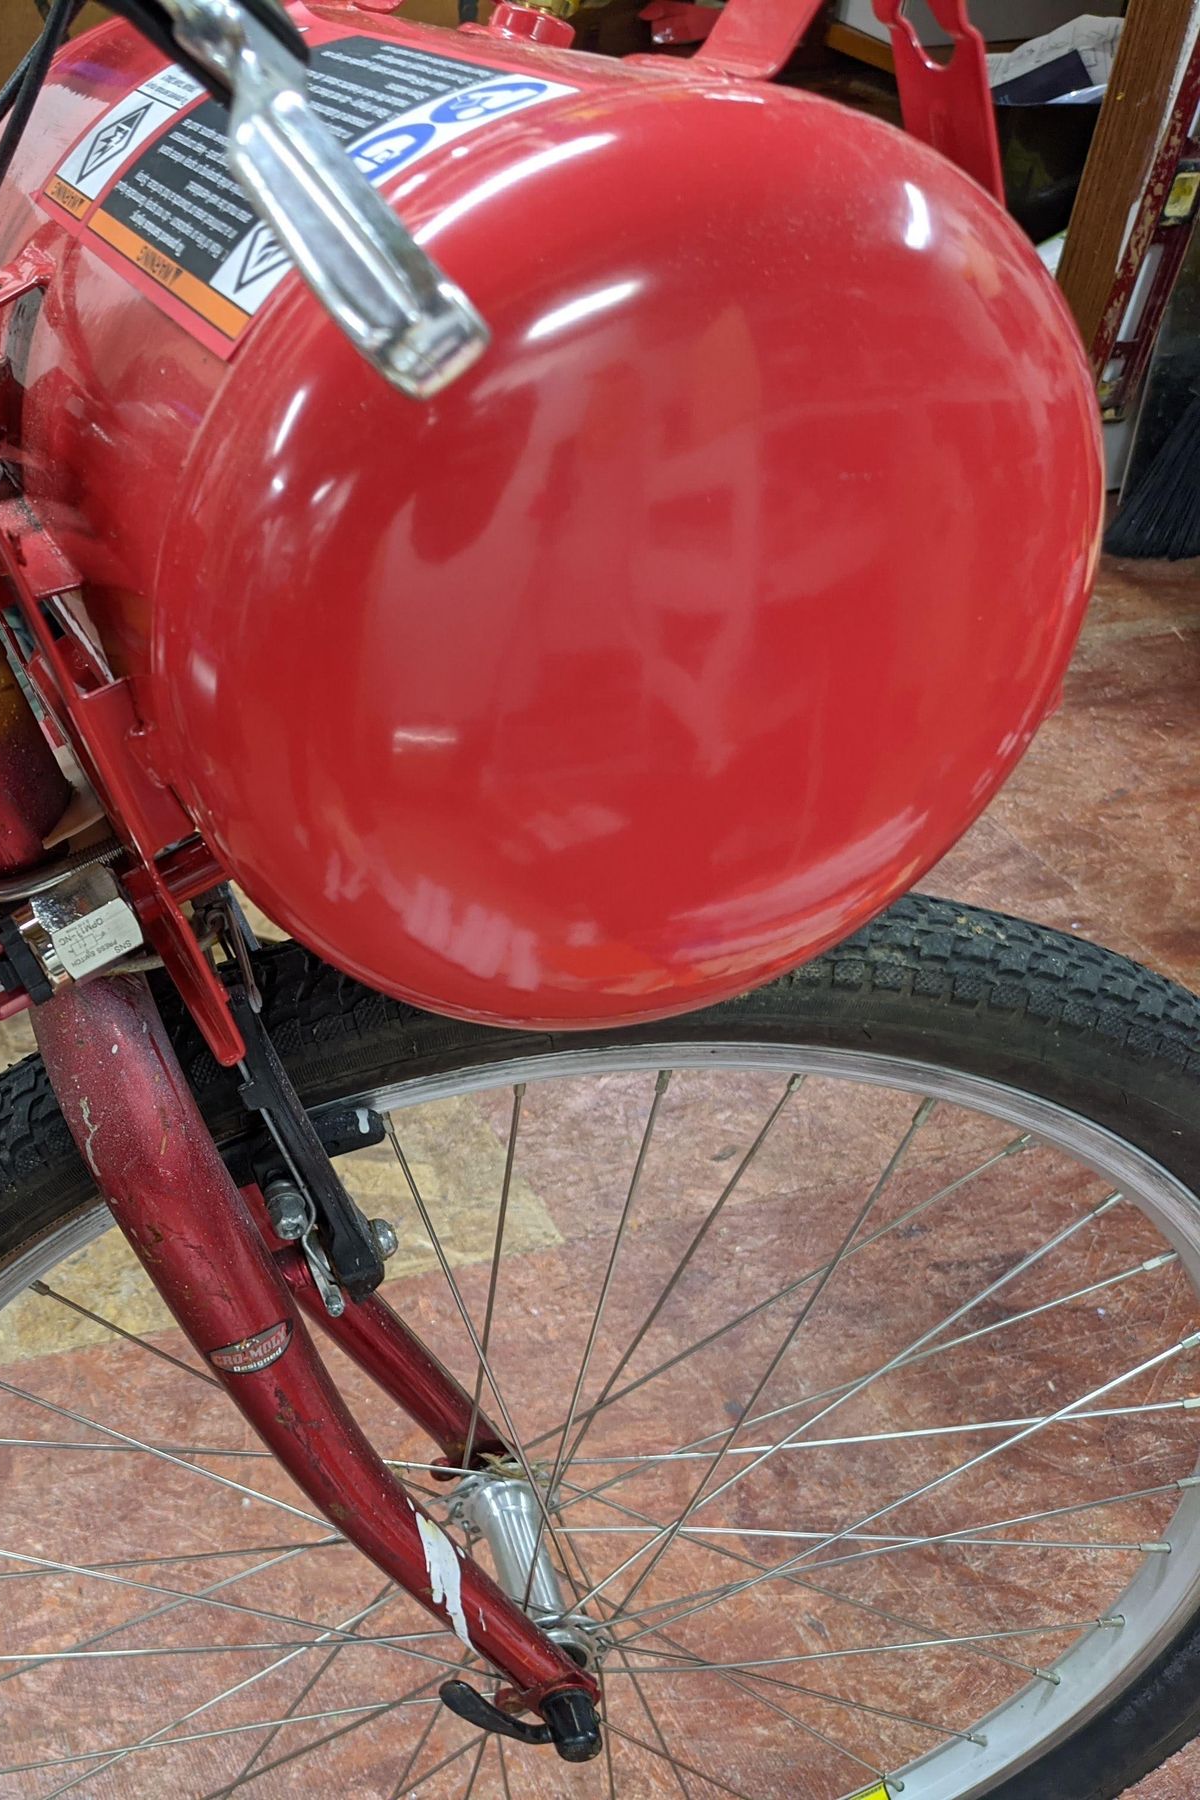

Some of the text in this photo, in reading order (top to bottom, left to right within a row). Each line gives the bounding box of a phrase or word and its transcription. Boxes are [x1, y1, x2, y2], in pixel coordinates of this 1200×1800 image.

[135, 247, 174, 279] WARNING
[70, 939, 117, 967] PRESS SWITCH
[113, 939, 131, 953] SNS
[233, 1347, 282, 1372] Designed
